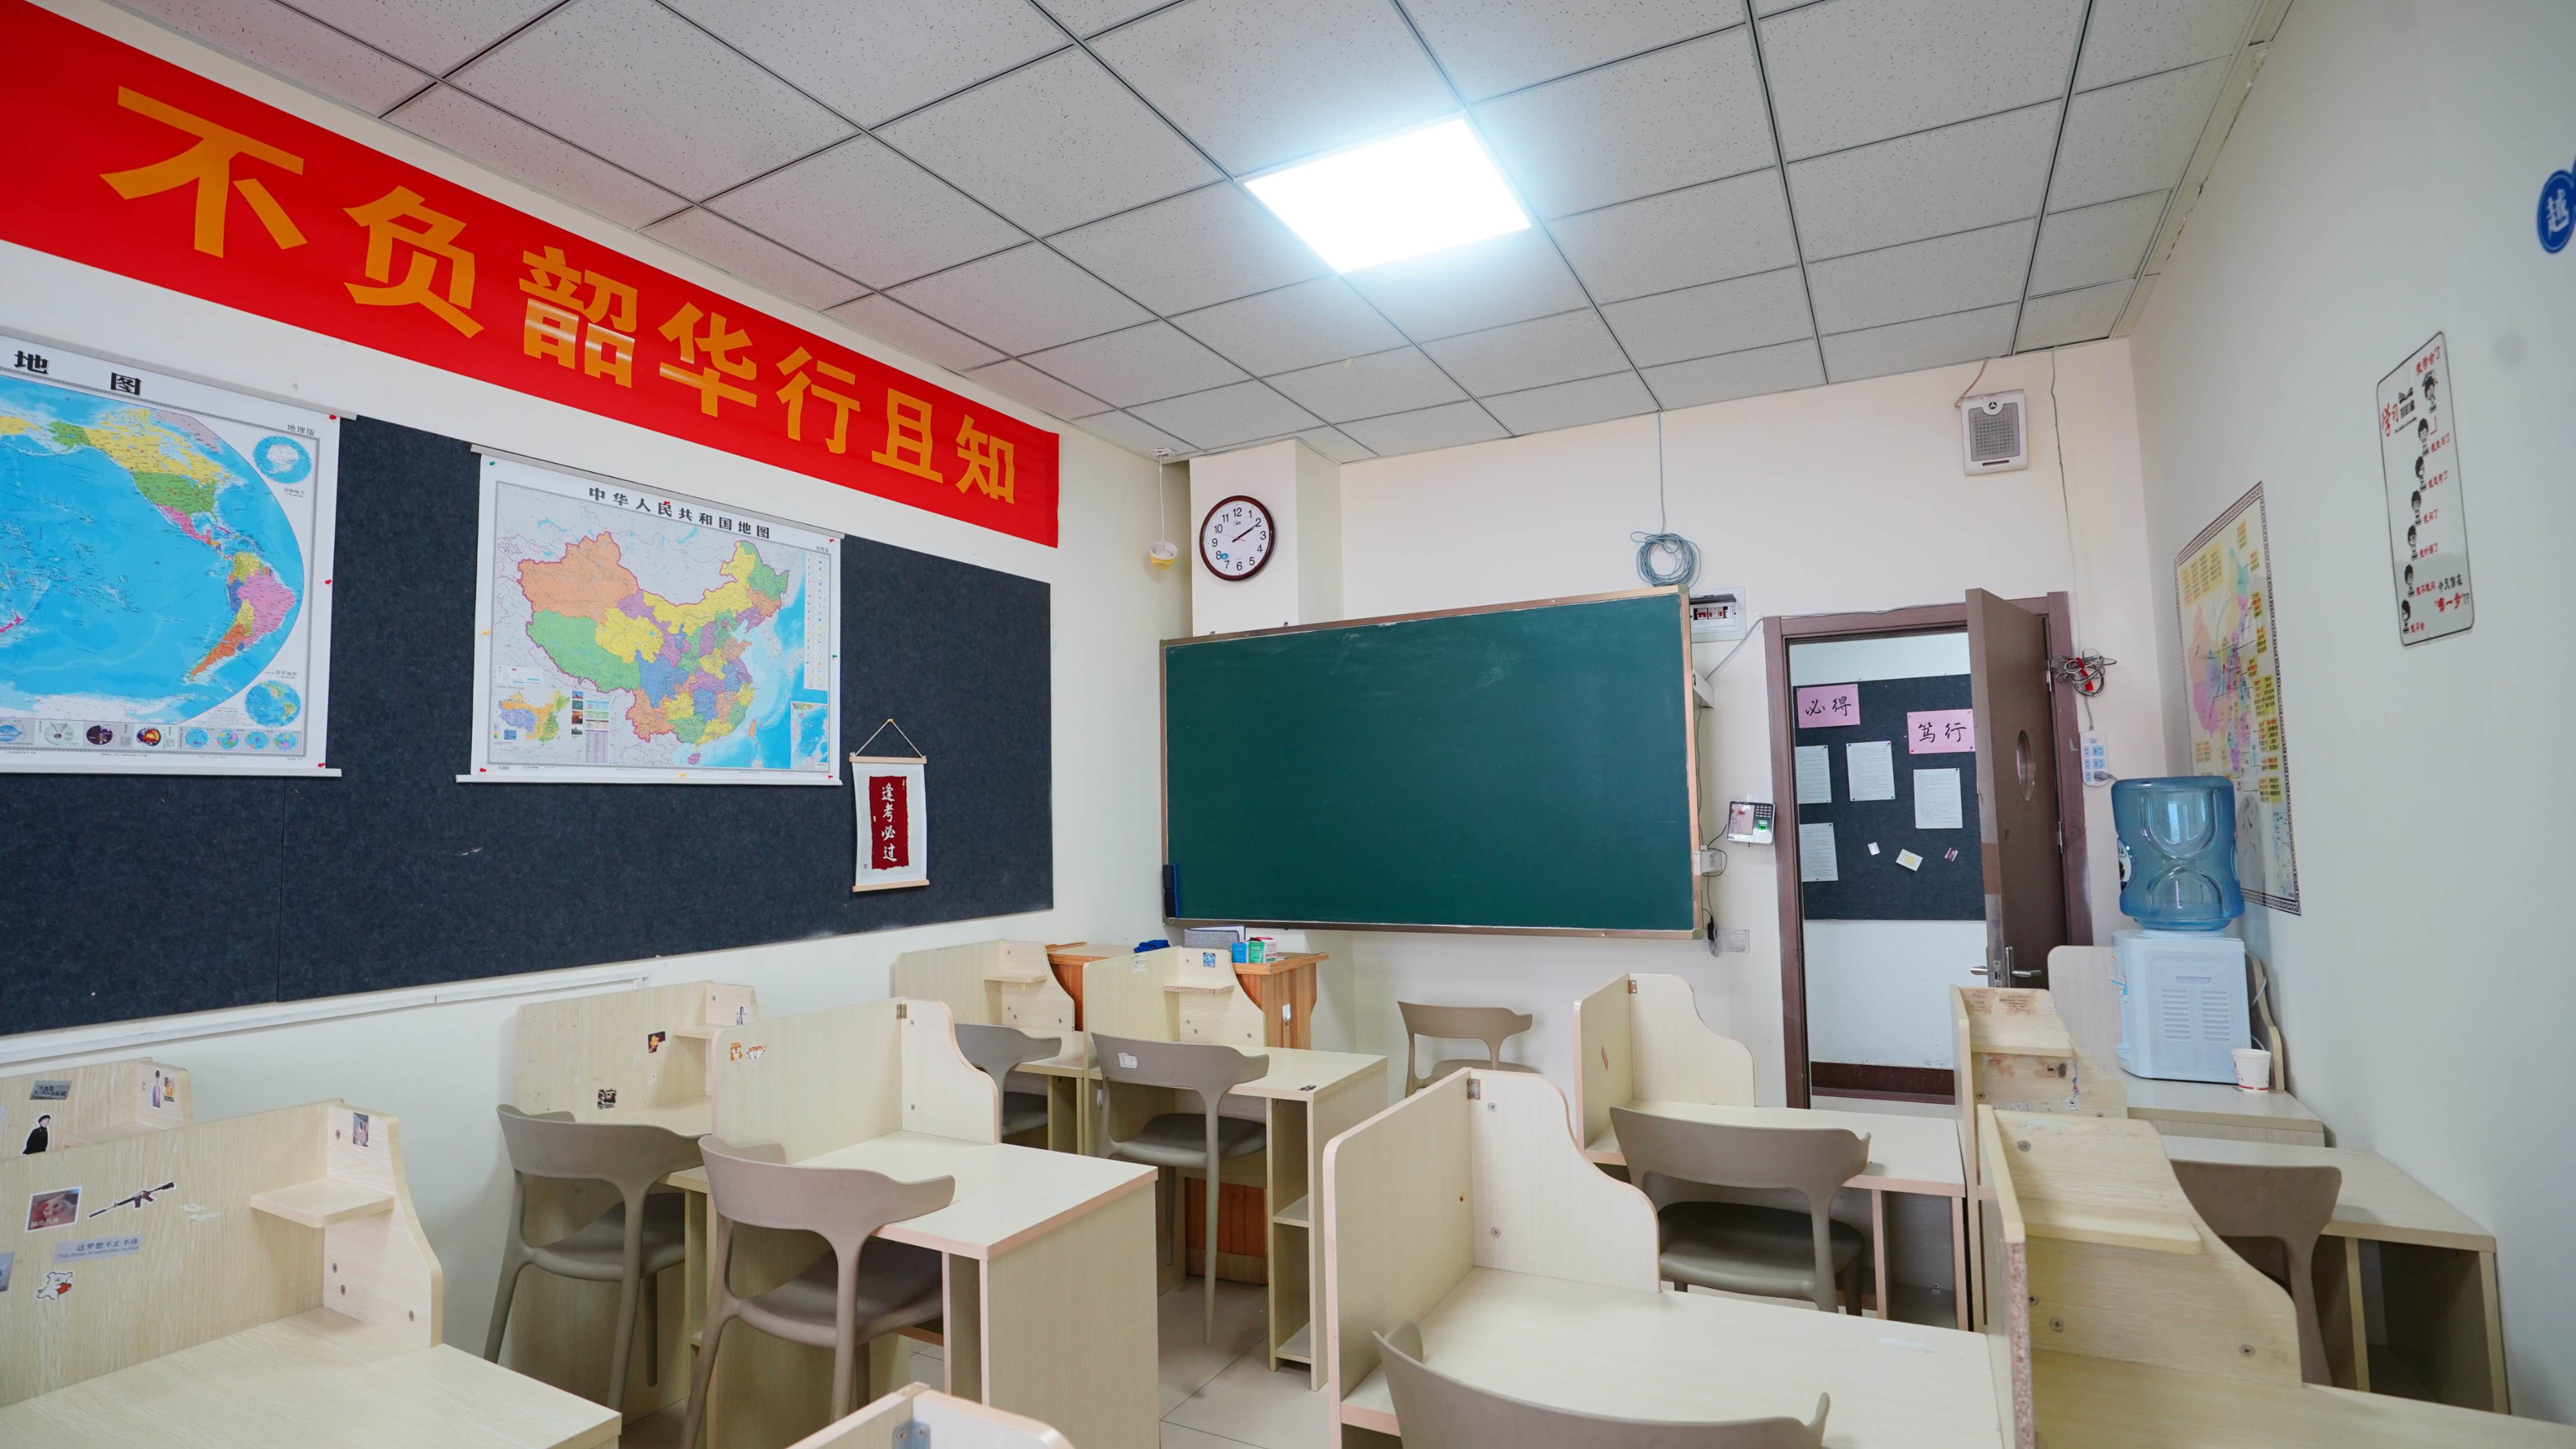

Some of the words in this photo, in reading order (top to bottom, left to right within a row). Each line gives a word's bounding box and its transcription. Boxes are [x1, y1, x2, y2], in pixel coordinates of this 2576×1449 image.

[2547, 188, 2570, 240] 越
[100, 85, 1015, 505] 不负韶华行且知
[2382, 402, 2399, 436] 学习
[287, 424, 315, 436] 地理版
[589, 487, 770, 539] 中华人民共和国地图
[1233, 507, 1242, 517] 12
[1249, 510, 1252, 518] 1
[1222, 514, 1229, 522] 11
[1256, 518, 1261, 527] 2
[1214, 524, 1223, 534] 10
[1260, 531, 1266, 540] 3
[1212, 538, 1218, 547] 9
[1257, 544, 1263, 553] 4
[1216, 551, 1221, 560] 8
[1225, 560, 1230, 569] 7
[1236, 561, 1243, 571] 6
[1249, 557, 1255, 565] 5
[1805, 696, 1852, 716] 必得
[1919, 722, 1966, 743] 笃行
[882, 782, 897, 862] 逢考必过
